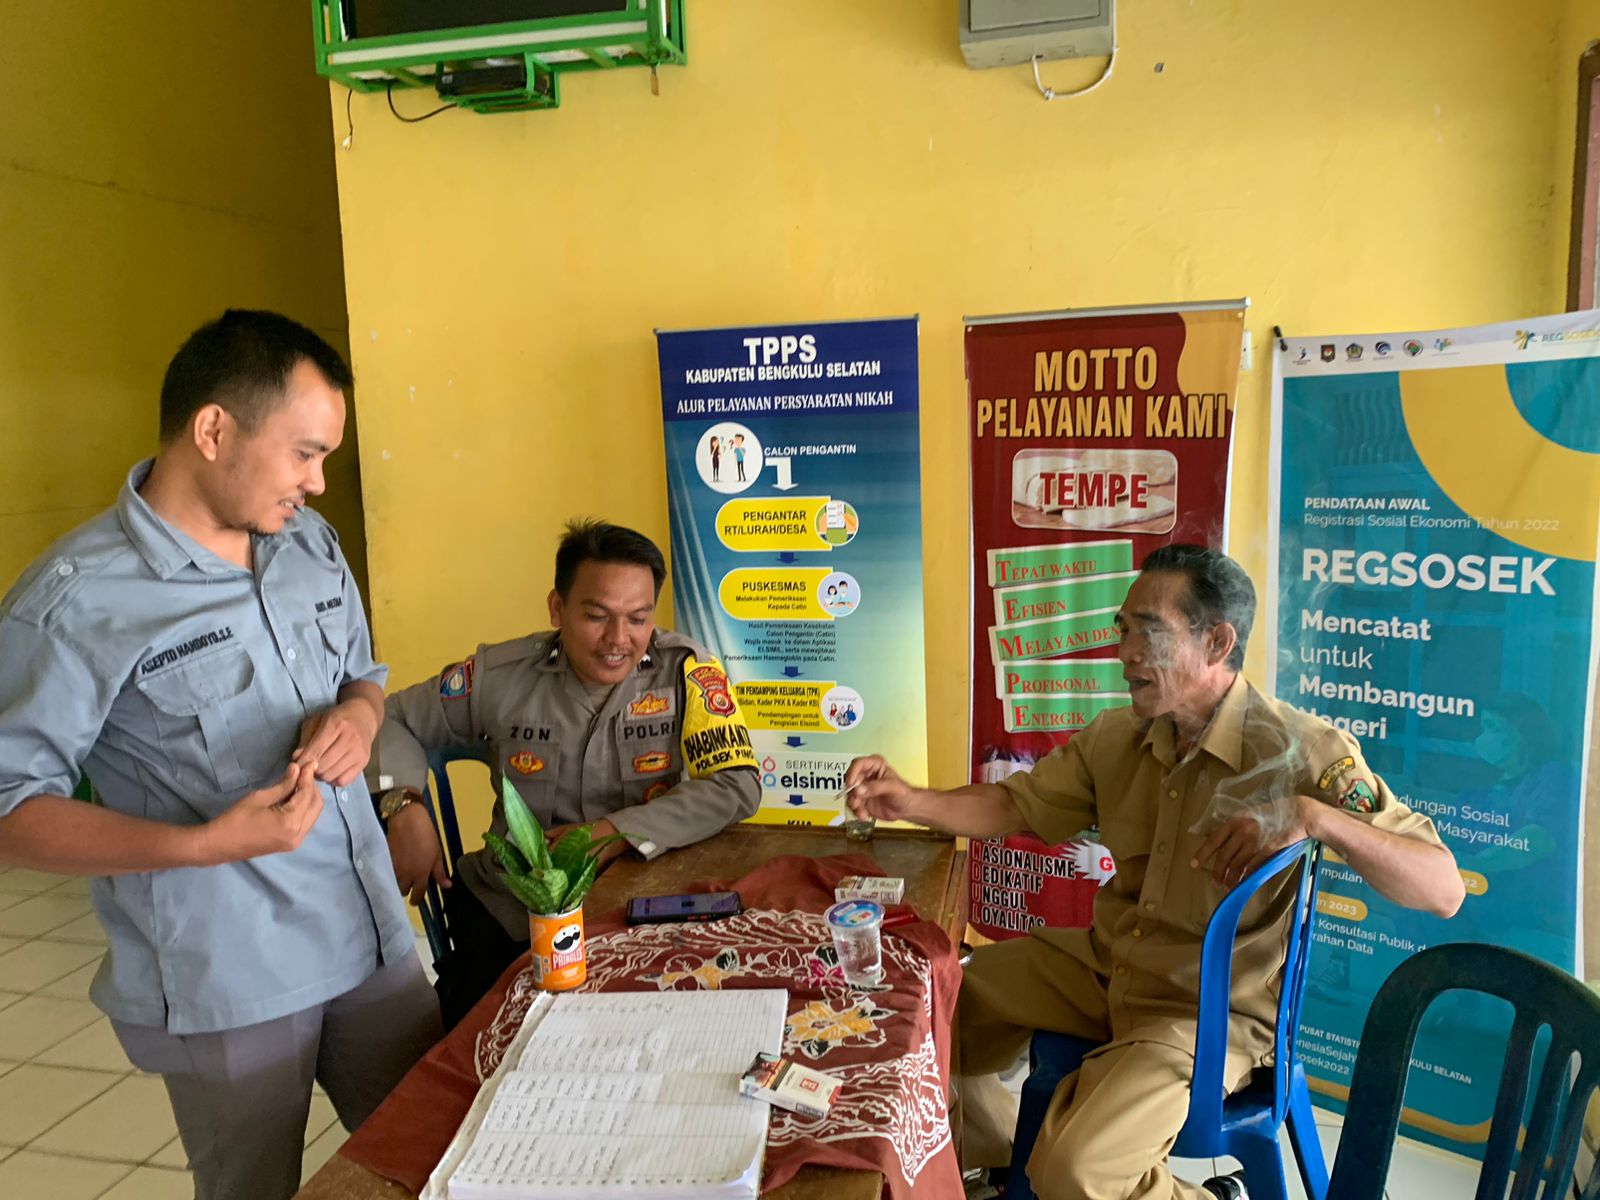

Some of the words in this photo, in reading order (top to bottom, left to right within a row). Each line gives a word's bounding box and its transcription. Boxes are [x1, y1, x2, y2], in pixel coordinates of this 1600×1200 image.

[743, 334, 817, 365] TPPS
[685, 366, 755, 384] KABUPATEN
[757, 363, 823, 381] BENGKULU
[826, 360, 881, 378] SELATAN
[1034, 346, 1158, 392] MOTTO
[676, 399, 705, 415] ALUR
[707, 396, 771, 413] PELAYANAN
[774, 393, 852, 411] PERSYARATAN
[855, 391, 893, 406] NIKAH
[976, 395, 1133, 438] PELAYANAN
[1145, 393, 1228, 439] KAMI
[764, 446, 797, 457] CALON
[799, 443, 857, 456] PENGANTIN
[1039, 471, 1148, 509] TEMPE
[1304, 497, 1386, 510] PENDATAAN
[1388, 498, 1431, 511] AWAL
[743, 511, 807, 521] PENGANTAR
[1304, 512, 1365, 528] Registrasi
[1367, 514, 1407, 527] Sosial
[1409, 515, 1471, 528] Ekonomi
[1475, 515, 1519, 529] Tahun
[1523, 519, 1561, 531] 2022
[724, 524, 807, 536] RT/LURAH/DESA
[996, 561, 1048, 582] TEPAT
[1049, 560, 1097, 577] WAKTU
[1302, 548, 1557, 596] REGSOSEK
[742, 581, 807, 592] PUSKESMAS
[768, 603, 791, 611] Kepada
[1005, 598, 1067, 621] EFISIEN
[1301, 608, 1432, 641] Mencatat
[999, 630, 1089, 660] MELAYANI
[1300, 646, 1374, 670] untuk
[736, 686, 745, 694] TIM
[1299, 674, 1475, 717] Membangun
[1014, 705, 1086, 727] ENERGIK
[510, 725, 551, 741] ZON
[624, 720, 676, 741] POLRI
[695, 750, 733, 773] POLSEK
[785, 760, 848, 771] SERTIFIKAT
[1461, 805, 1510, 827] Sosial
[1437, 820, 1530, 852] Masyarakat
[1329, 900, 1358, 917] 2023
[1319, 919, 1377, 941] Konsultasi
[1379, 933, 1415, 951] Publik
[552, 944, 583, 970] PRINGLES
[1347, 939, 1374, 955] Data
[1299, 1023, 1325, 1038] PUSAT
[1433, 1065, 1472, 1084] SELATAN
